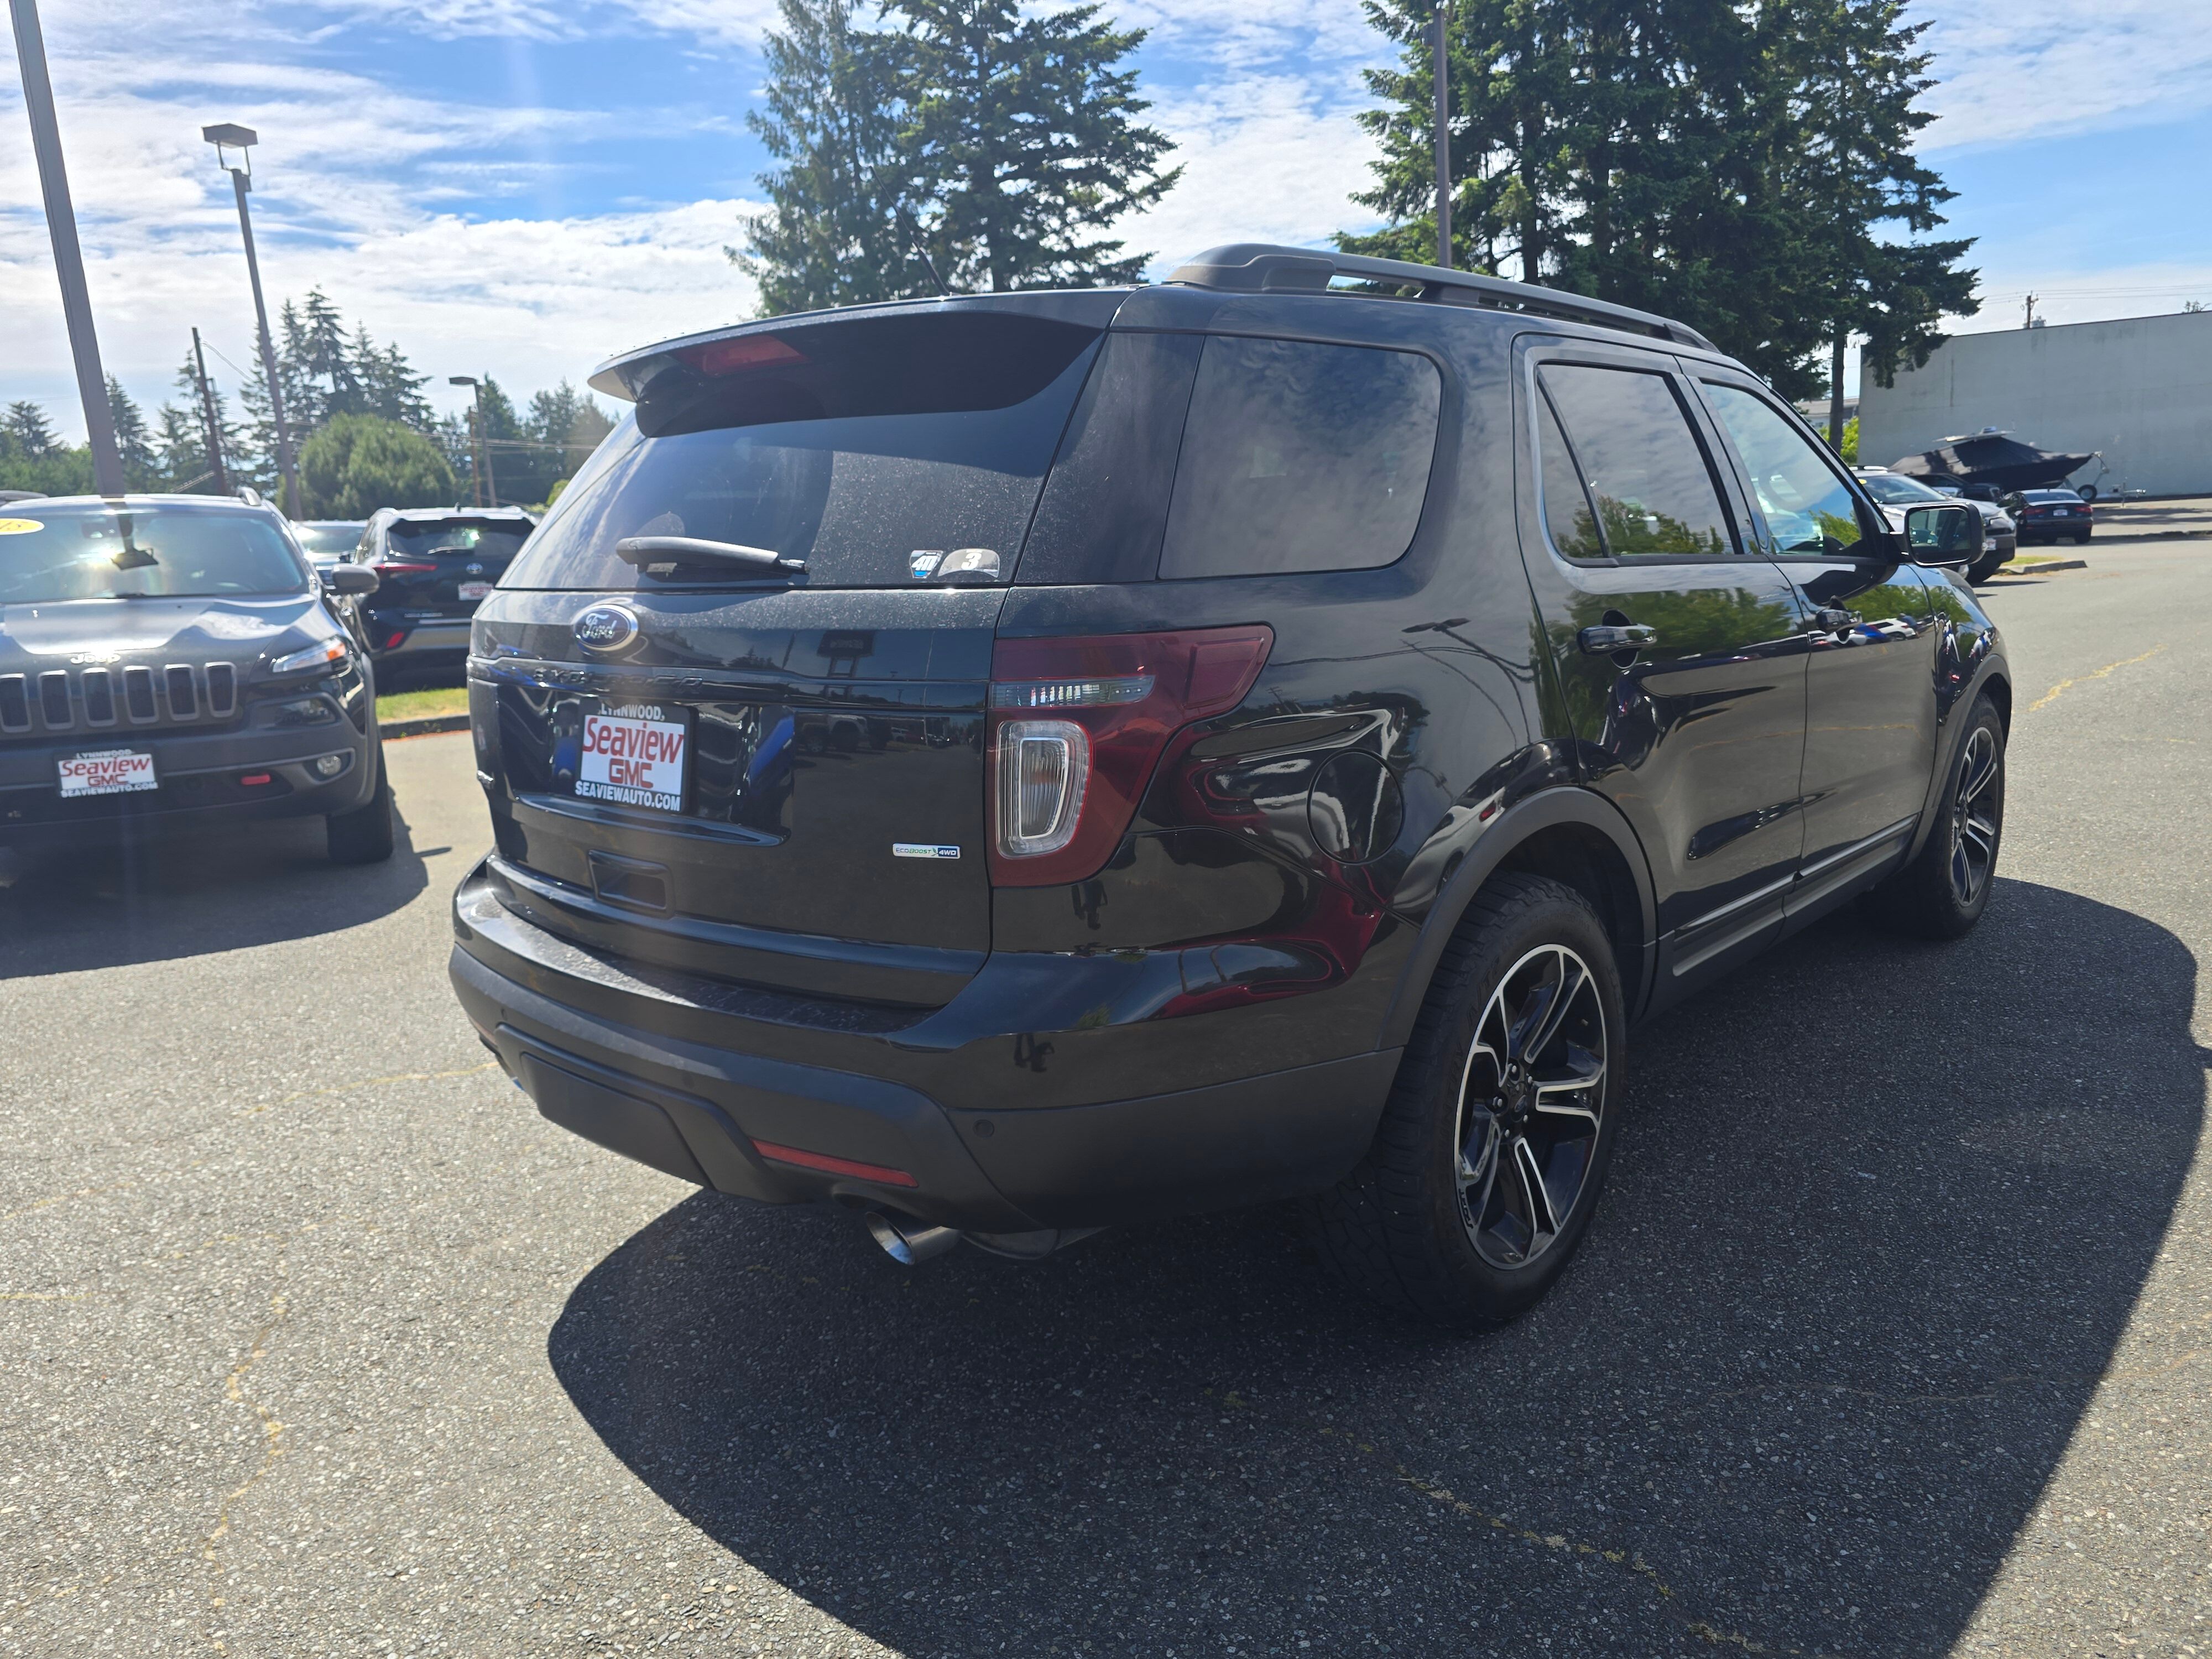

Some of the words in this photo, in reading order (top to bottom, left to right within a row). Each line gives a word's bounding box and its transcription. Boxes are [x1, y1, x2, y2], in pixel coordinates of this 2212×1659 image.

[961, 552, 982, 570] 3
[582, 613, 617, 639] Ford
[70, 653, 121, 664] Jeep
[582, 717, 684, 763] Seaview
[61, 757, 150, 777] Seaview
[609, 758, 654, 789] GMC
[61, 781, 158, 798] SEAVIEWAUTO.COM
[87, 773, 128, 786] GMC
[575, 780, 680, 811] SEAVIEWAUTO.COM
